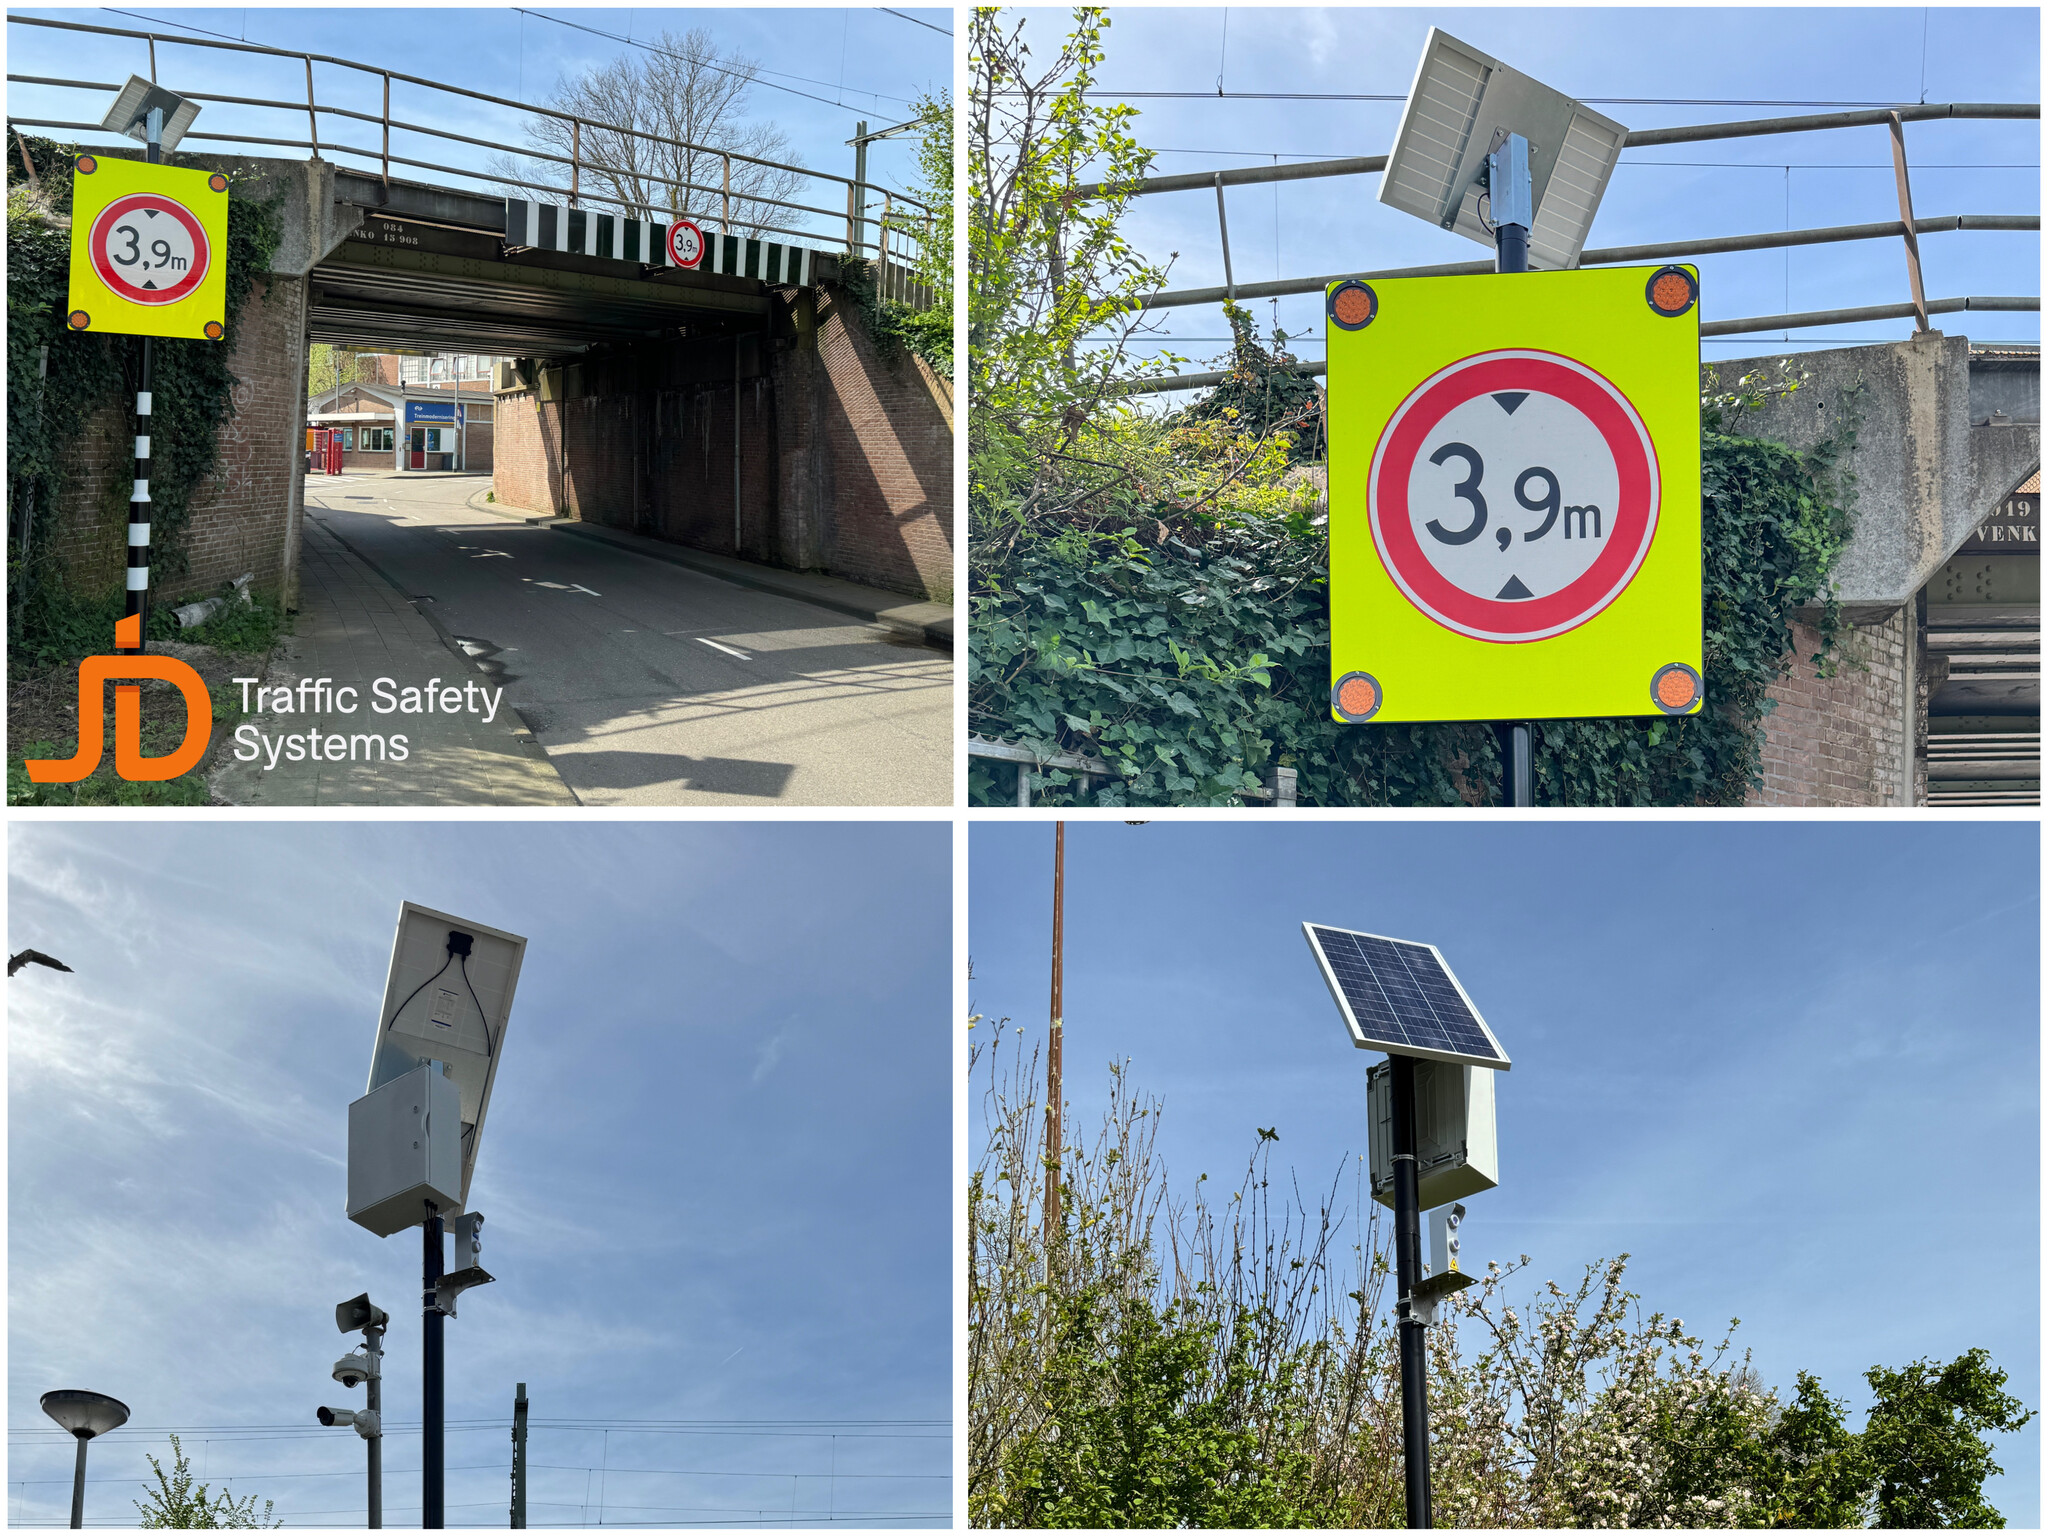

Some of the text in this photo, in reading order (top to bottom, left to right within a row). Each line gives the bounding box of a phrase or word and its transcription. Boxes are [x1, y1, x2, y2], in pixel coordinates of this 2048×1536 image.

[350, 229, 375, 239] NKO
[383, 222, 404, 233] 084
[113, 225, 187, 271] 3,9m
[675, 233, 698, 253] 3,9m
[1425, 442, 1601, 552] 3,9m
[1976, 525, 2037, 542] VENK
